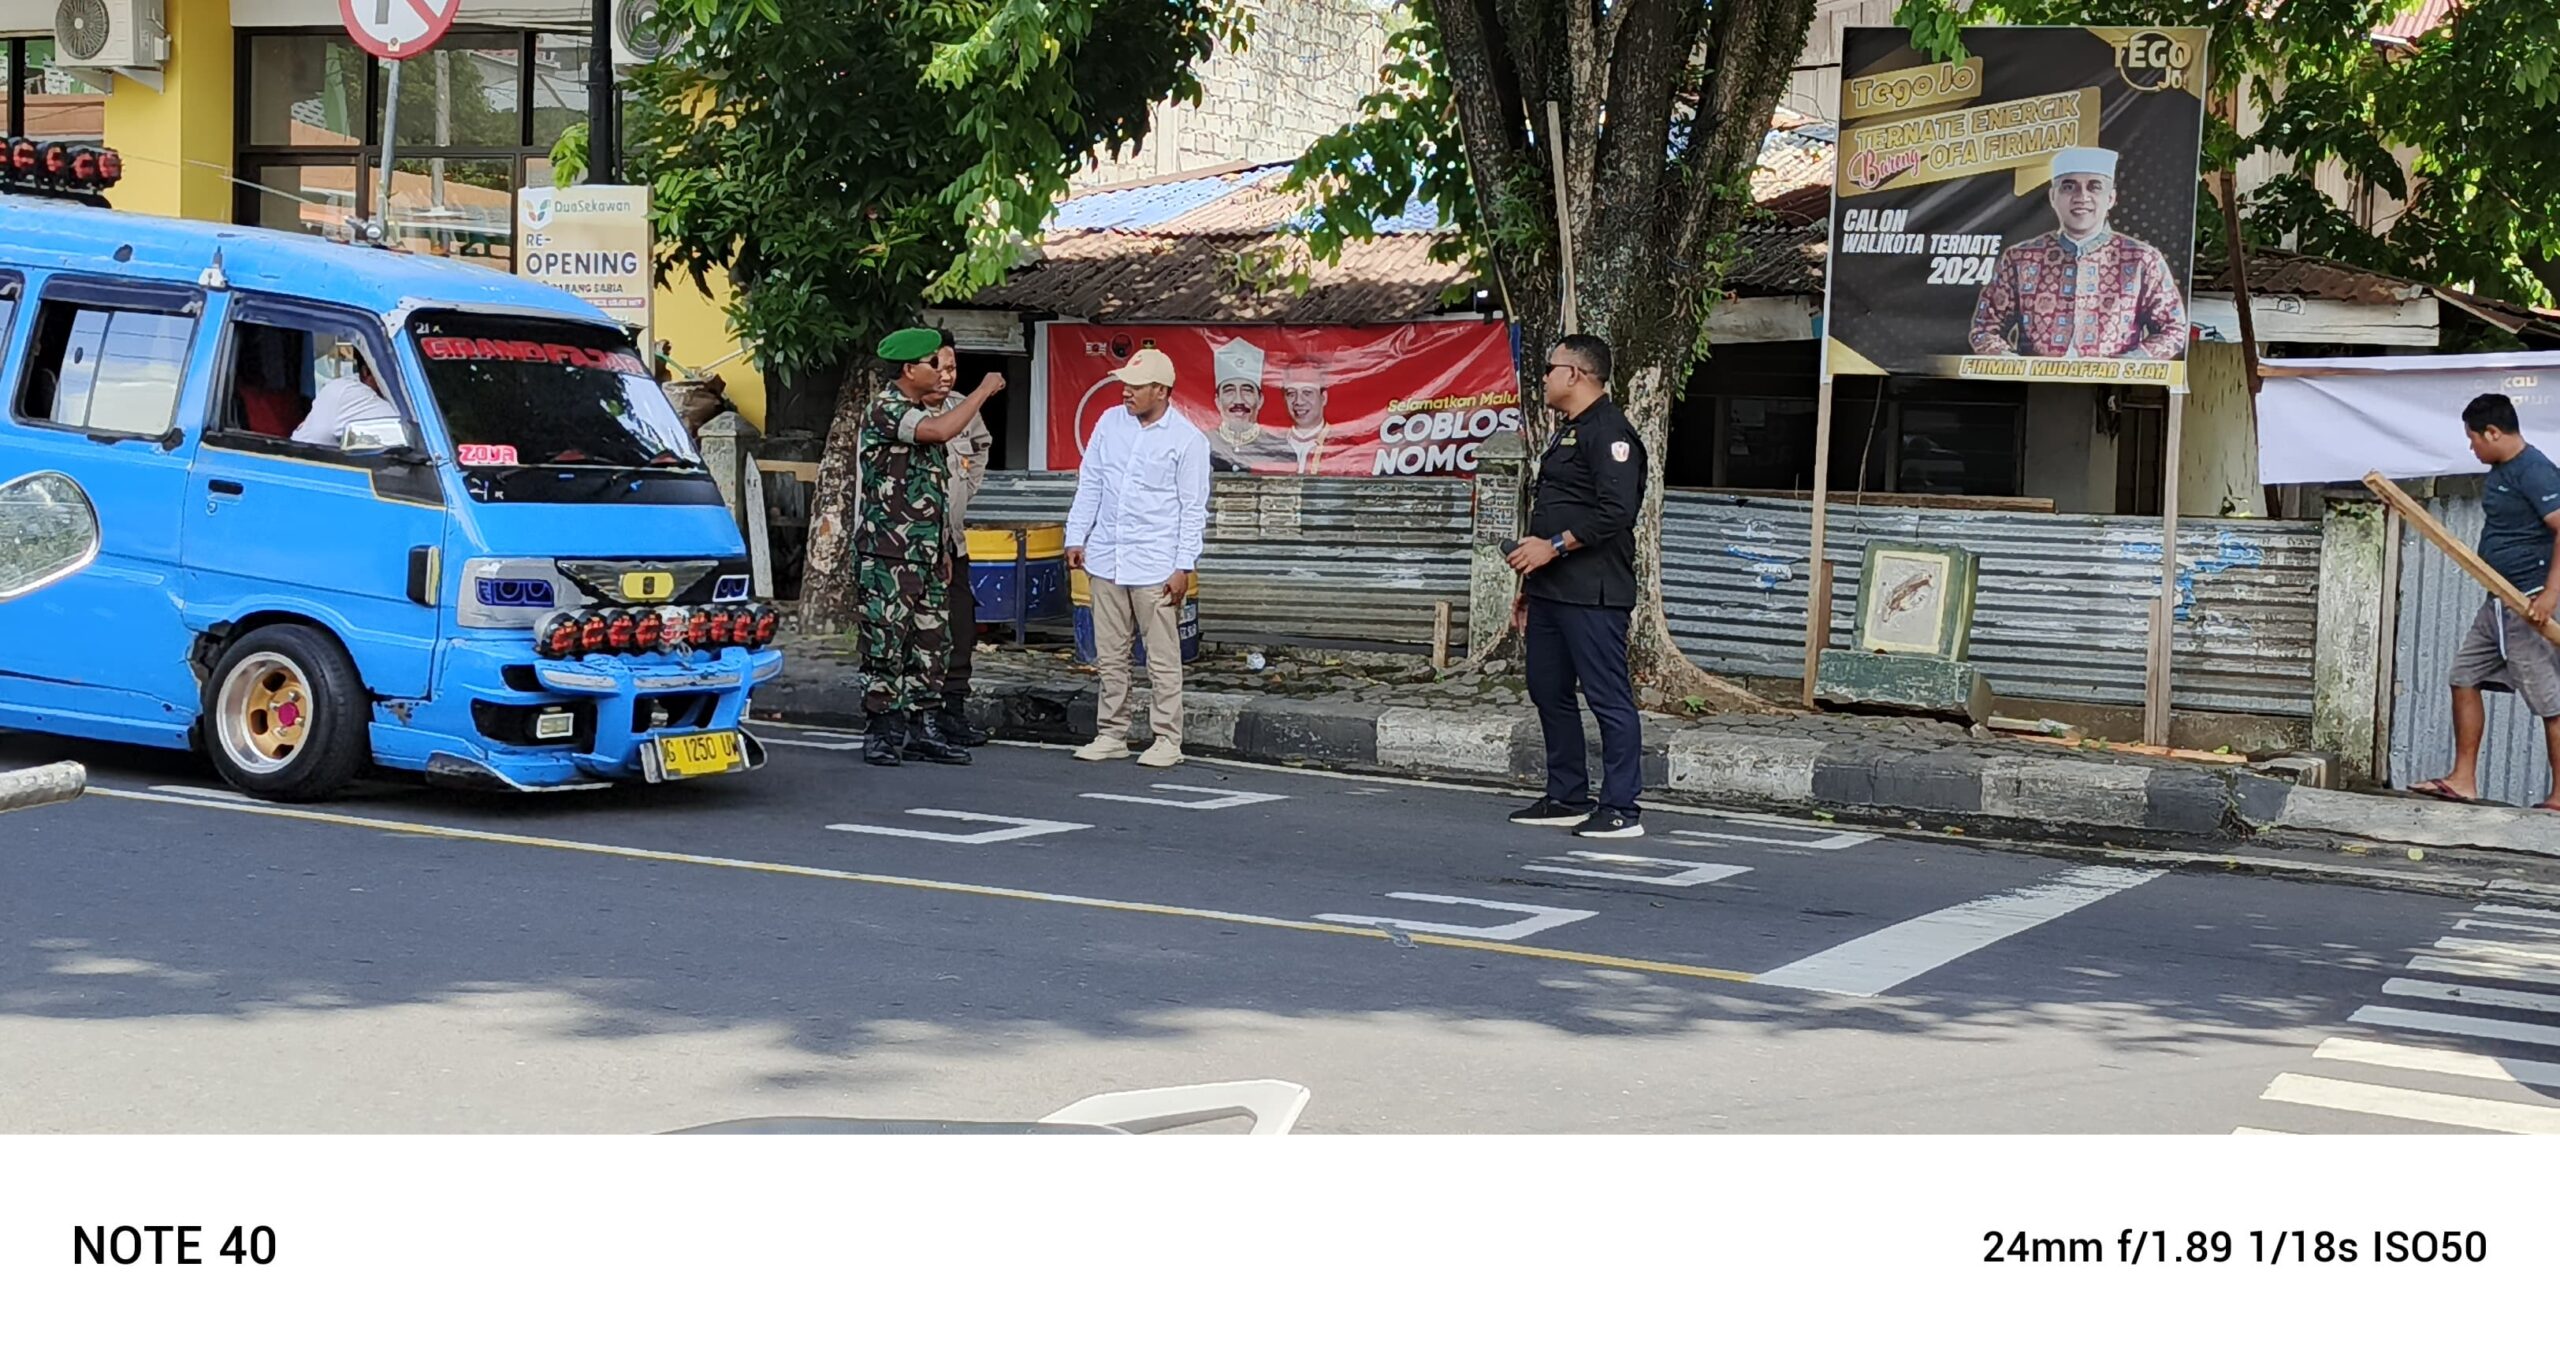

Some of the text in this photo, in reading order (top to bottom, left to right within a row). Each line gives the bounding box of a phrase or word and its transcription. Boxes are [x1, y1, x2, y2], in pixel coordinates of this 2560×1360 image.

[2111, 40, 2192, 68] TEGO
[1853, 66, 1974, 107] Tego Jo
[1857, 95, 2079, 152] TERNATE ENERGIK
[1929, 140, 1979, 170] OFA
[1983, 122, 2077, 162] FIRMAN
[554, 199, 631, 213] DuaSekawan
[1843, 209, 1908, 232] CALON
[526, 233, 552, 247] RE-
[1842, 233, 2002, 255] WALIKOTA TERNATE
[526, 252, 637, 275] OPENING
[1927, 257, 1996, 285] 2024
[1961, 358, 2026, 376] FIRMAN
[2030, 360, 2119, 379] MUDAFFAR
[1388, 396, 1476, 412] Selamatkan
[1380, 407, 1520, 443] COBLOS
[683, 737, 716, 762] 1250
